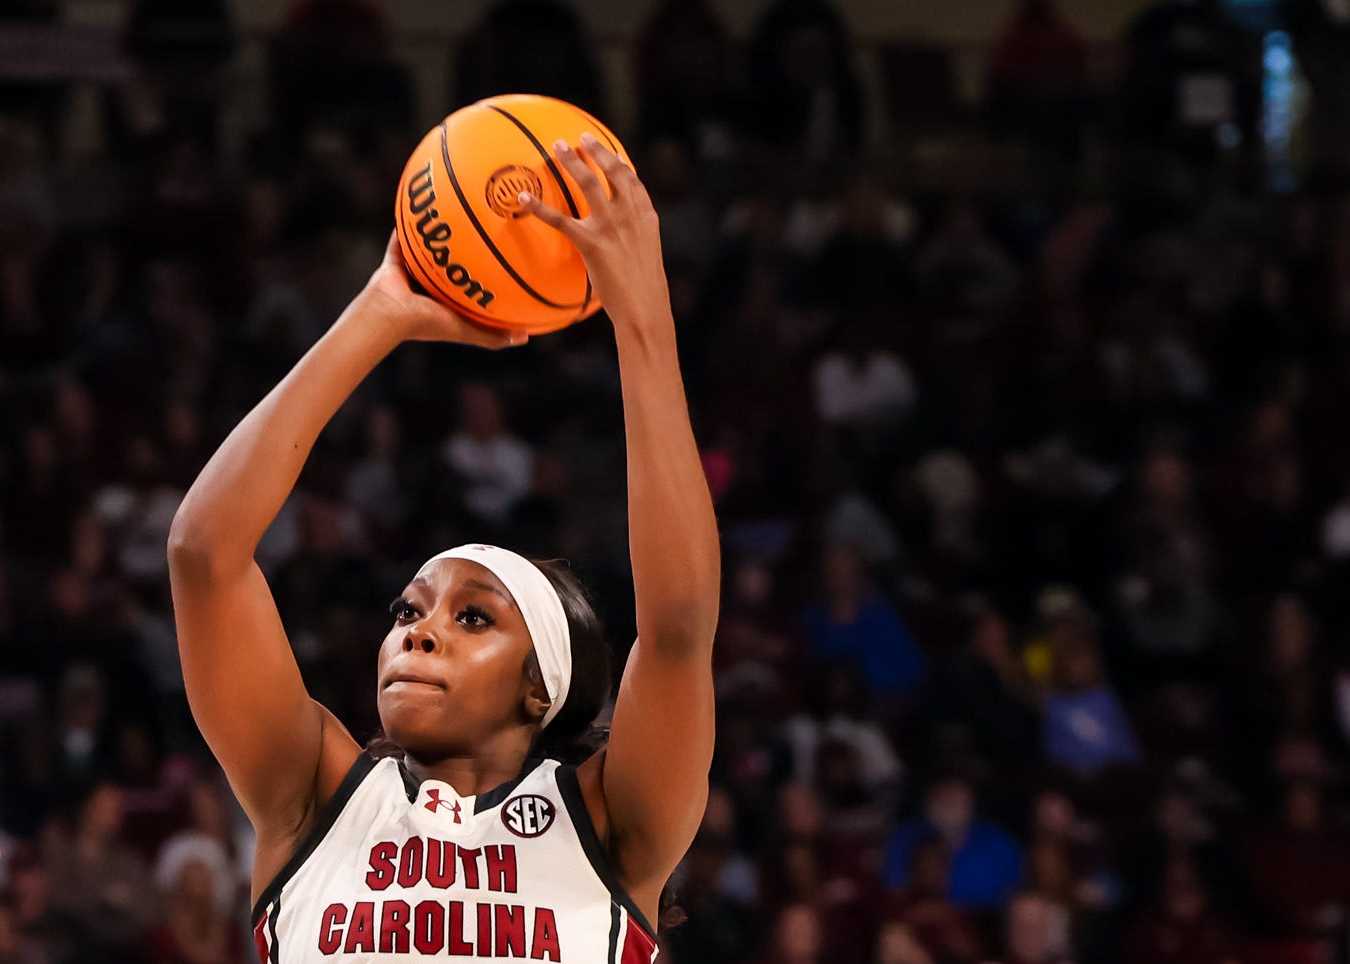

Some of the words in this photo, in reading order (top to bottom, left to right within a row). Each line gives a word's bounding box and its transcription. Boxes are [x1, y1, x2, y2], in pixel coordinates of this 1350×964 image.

[407, 158, 496, 309] Wilson
[505, 796, 551, 834] SEC
[365, 836, 518, 894] SOUTH
[317, 900, 561, 963] CAROLINA
